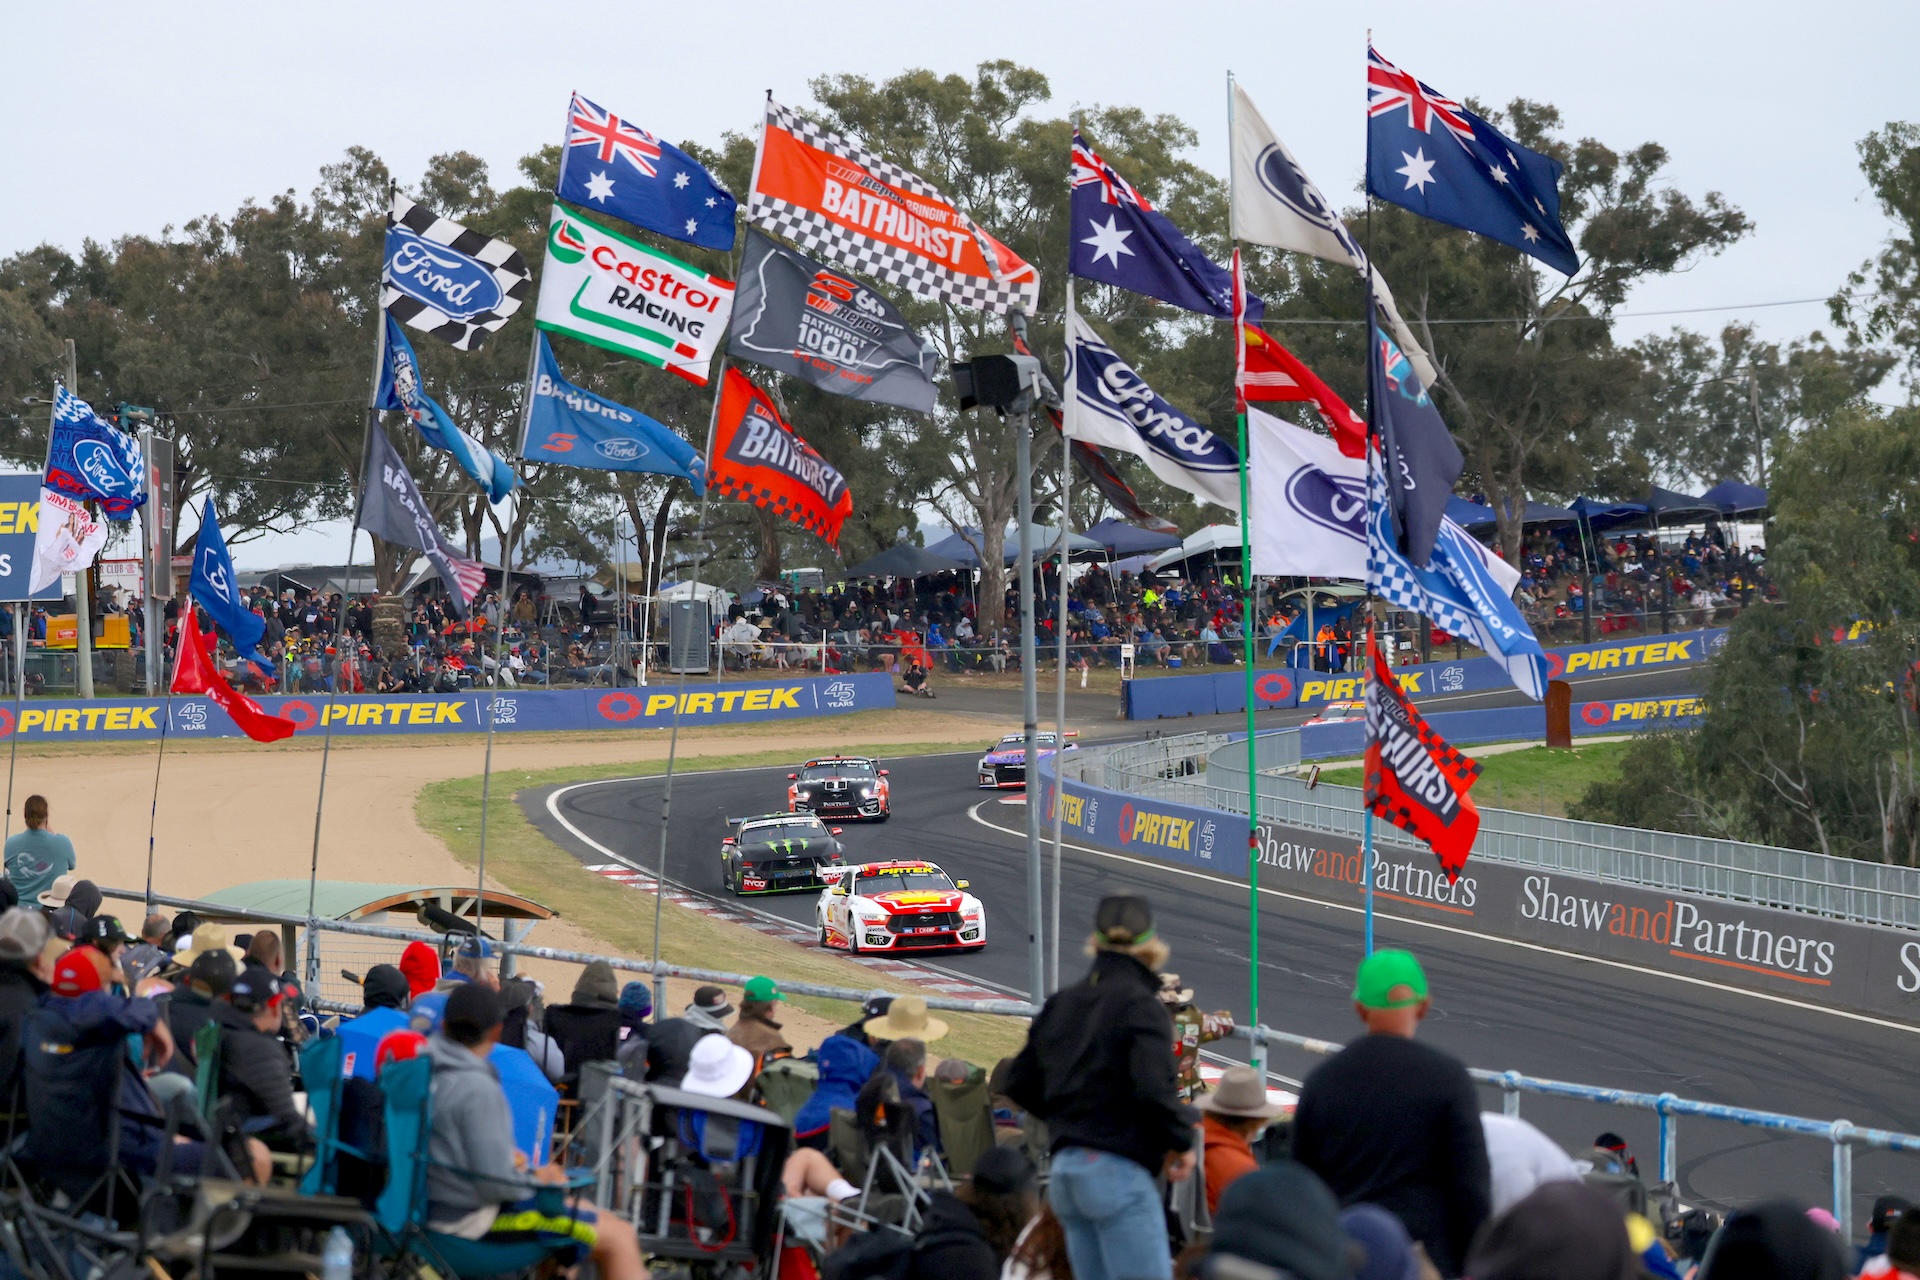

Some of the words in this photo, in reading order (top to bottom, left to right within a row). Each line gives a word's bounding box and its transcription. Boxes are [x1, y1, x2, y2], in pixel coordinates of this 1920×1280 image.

[821, 178, 970, 265] BATHURST
[392, 242, 481, 306] Ford
[591, 246, 721, 313] Castrol
[608, 285, 706, 340] RACING
[801, 313, 868, 349] BATHURST
[797, 323, 858, 366] 1000
[812, 359, 837, 373] OCT
[1097, 361, 1215, 456] Ford
[603, 440, 639, 458] Ford
[737, 414, 844, 502] BATHURST
[83, 446, 126, 493] Ford
[107, 564, 124, 574] CLUB
[1566, 639, 1694, 674] PIRTEK
[1300, 671, 1424, 703] PIRTK
[1439, 667, 1465, 686] 45
[1442, 684, 1463, 692] YEARS
[644, 687, 804, 716] PIRTEK
[823, 681, 856, 702] 45
[827, 700, 855, 708] YEARS
[17, 706, 161, 733] PIRTEK
[178, 702, 208, 725] 45
[320, 701, 467, 727] PIRTEK
[486, 697, 518, 719] 45
[181, 723, 207, 731] YEARS
[1132, 811, 1196, 852] PIRTEK
[1201, 820, 1216, 851] 45
[743, 880, 766, 888] RYCO
[879, 867, 934, 875] PIRTEK
[868, 934, 885, 945] OTR
[964, 929, 978, 940] OTR
